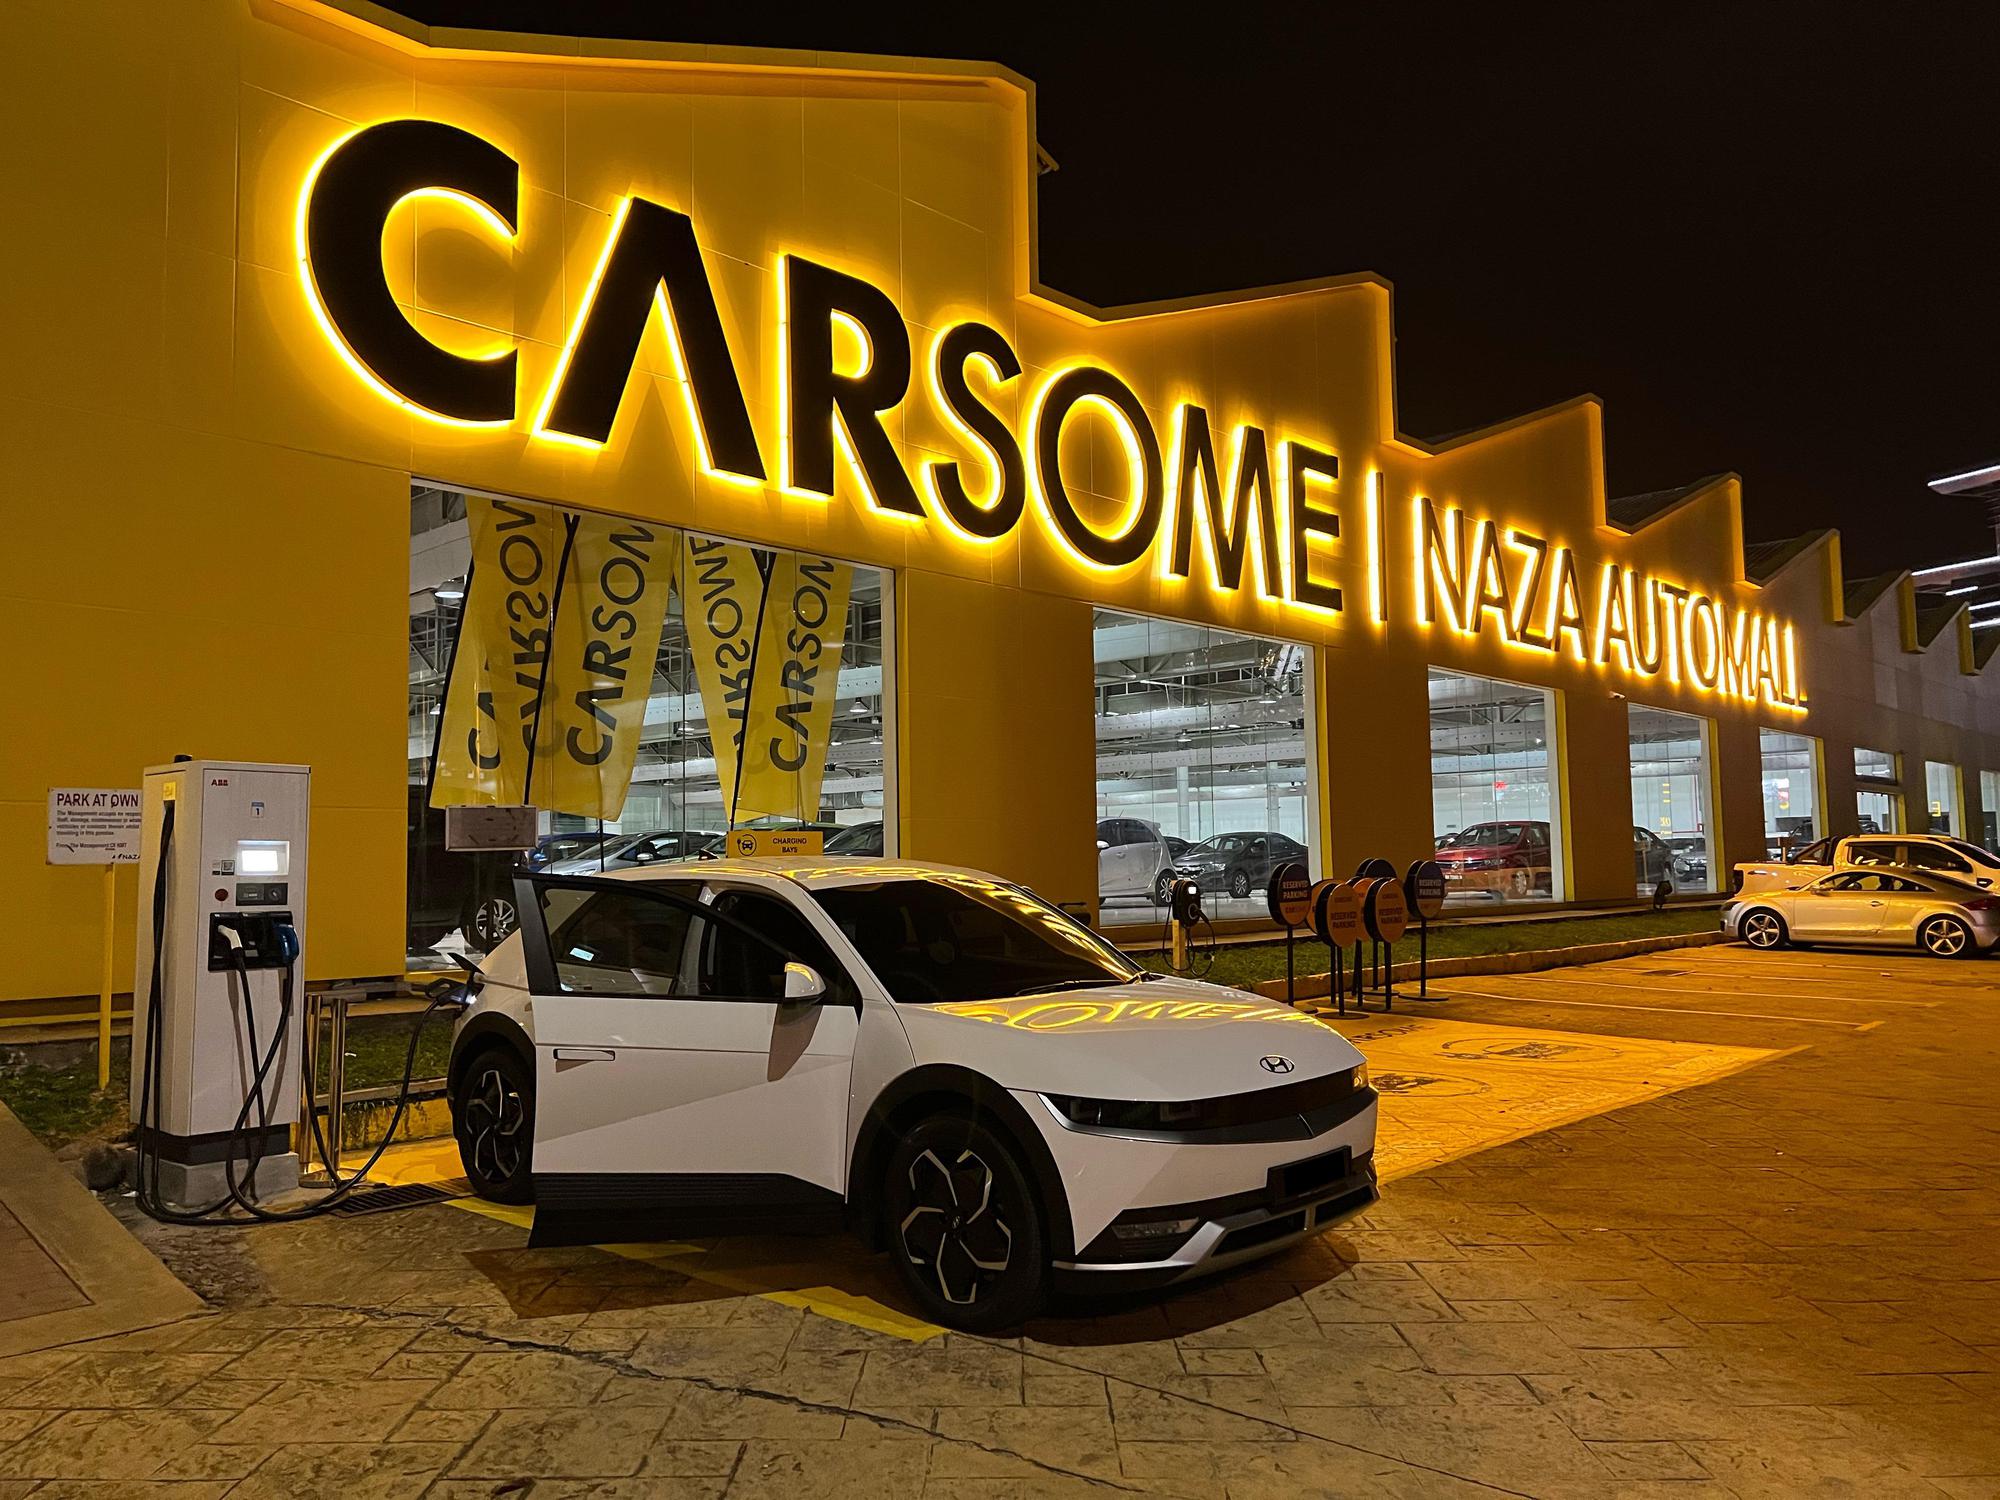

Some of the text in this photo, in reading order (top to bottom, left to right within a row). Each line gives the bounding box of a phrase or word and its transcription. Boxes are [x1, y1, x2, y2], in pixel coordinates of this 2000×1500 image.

[299, 118, 1344, 613] CARSOME
[1414, 496, 1588, 661] NAZA
[1595, 563, 1809, 714] AUTOMALL
[57, 793, 139, 807] PARK AT OWN
[772, 837, 807, 845] CHARGING
[1282, 880, 1309, 889] RESERVED
[1419, 879, 1442, 887] RESERVED
[1283, 890, 1308, 899] PARKING
[1331, 912, 1357, 920] RESERVED
[1332, 921, 1356, 929] PARKING
